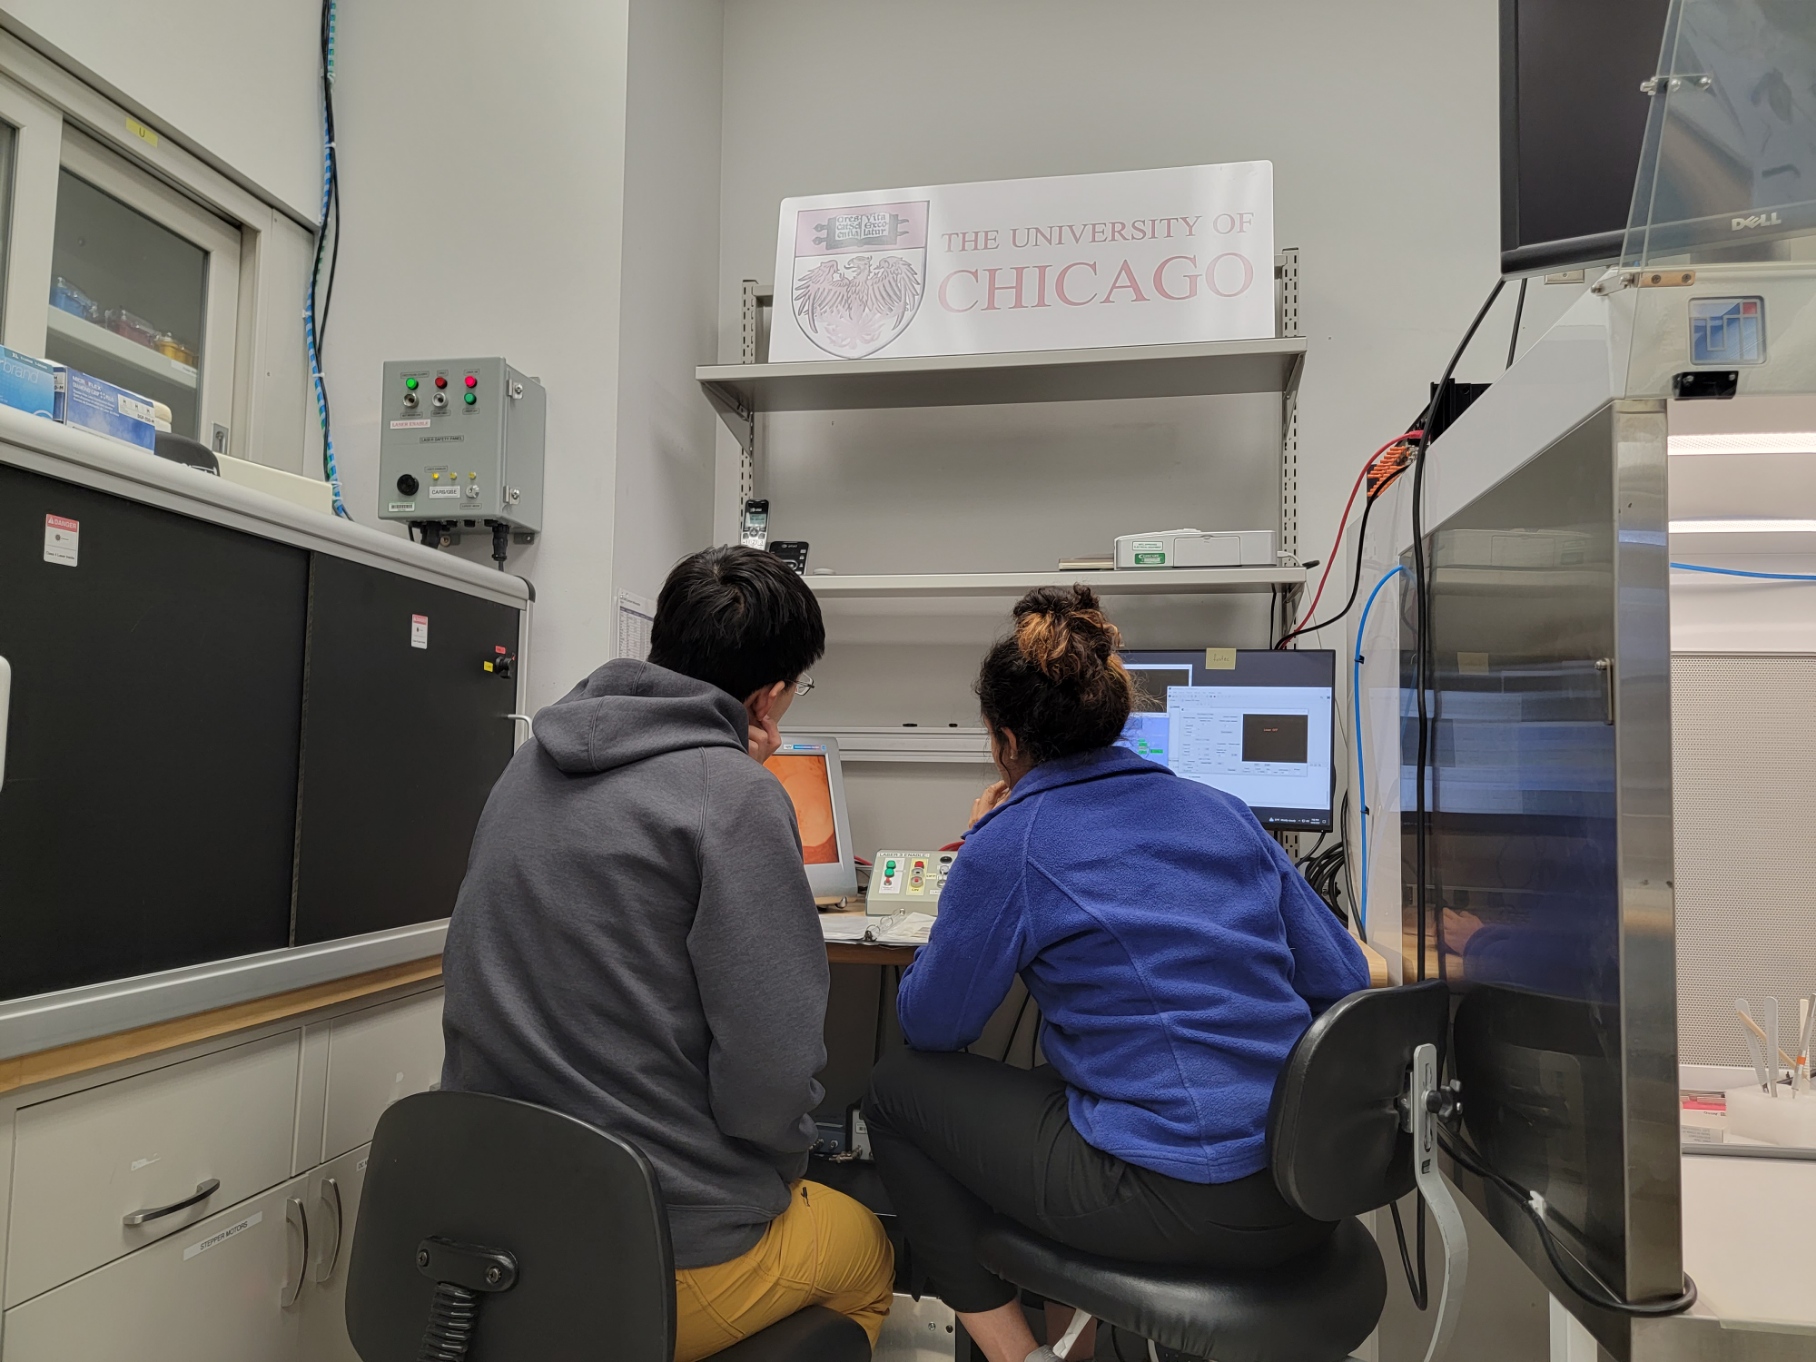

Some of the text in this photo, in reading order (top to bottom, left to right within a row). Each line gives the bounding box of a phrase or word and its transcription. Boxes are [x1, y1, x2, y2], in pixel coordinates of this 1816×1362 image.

[941, 212, 1254, 253] THE UNIVERSITY OF
[1731, 211, 1782, 231] DELL
[937, 252, 1254, 314] CHICAGO
[54, 518, 77, 528] DANGER
[200, 1220, 248, 1250] STEPPER MOTORS
